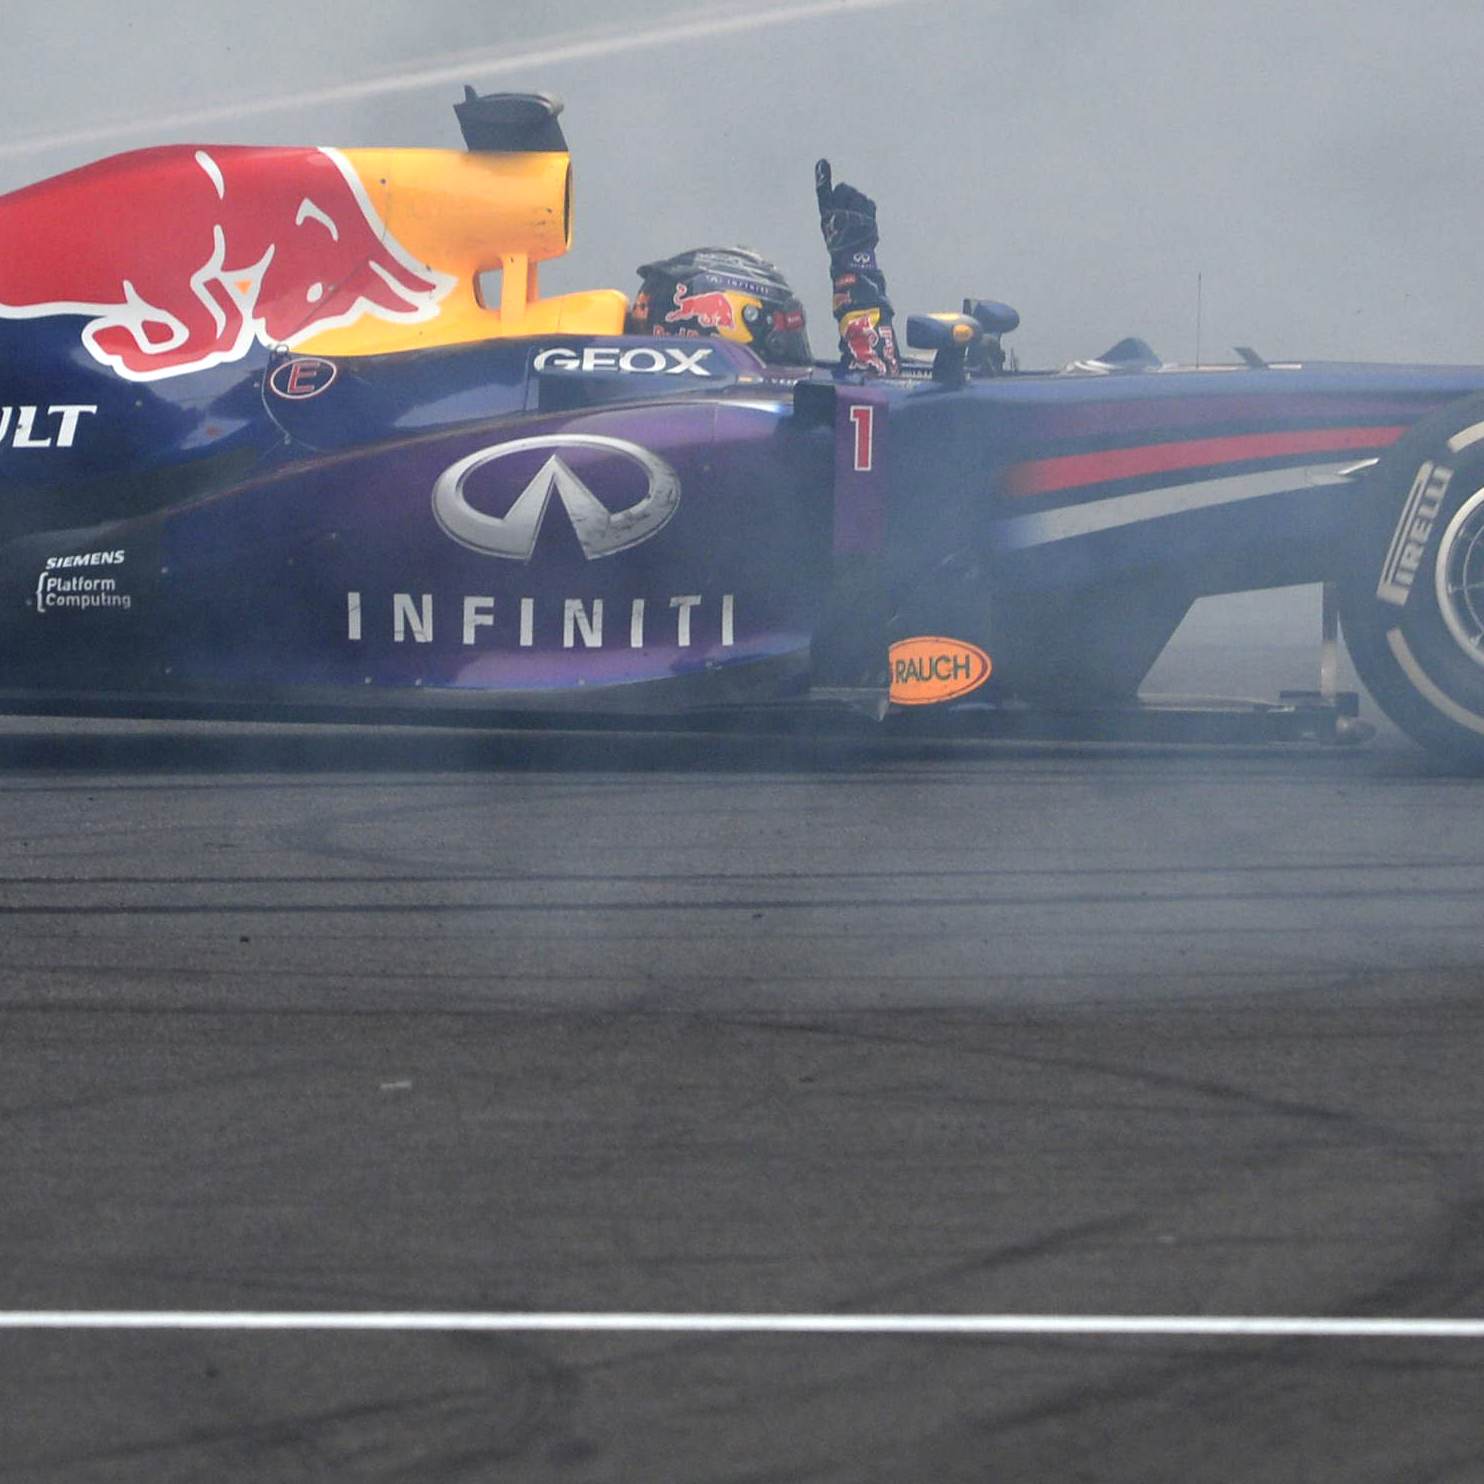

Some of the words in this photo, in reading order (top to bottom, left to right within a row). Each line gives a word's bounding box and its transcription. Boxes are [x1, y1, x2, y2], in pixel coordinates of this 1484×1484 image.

[533, 347, 713, 377] GEOX
[849, 405, 873, 472] 1
[1376, 460, 1454, 606] PIRELLI
[45, 550, 125, 570] SIEMENS
[46, 576, 116, 592] Platform
[45, 592, 132, 610] Computing
[346, 591, 734, 648] INFINITI
[895, 654, 971, 684] RAUCH
